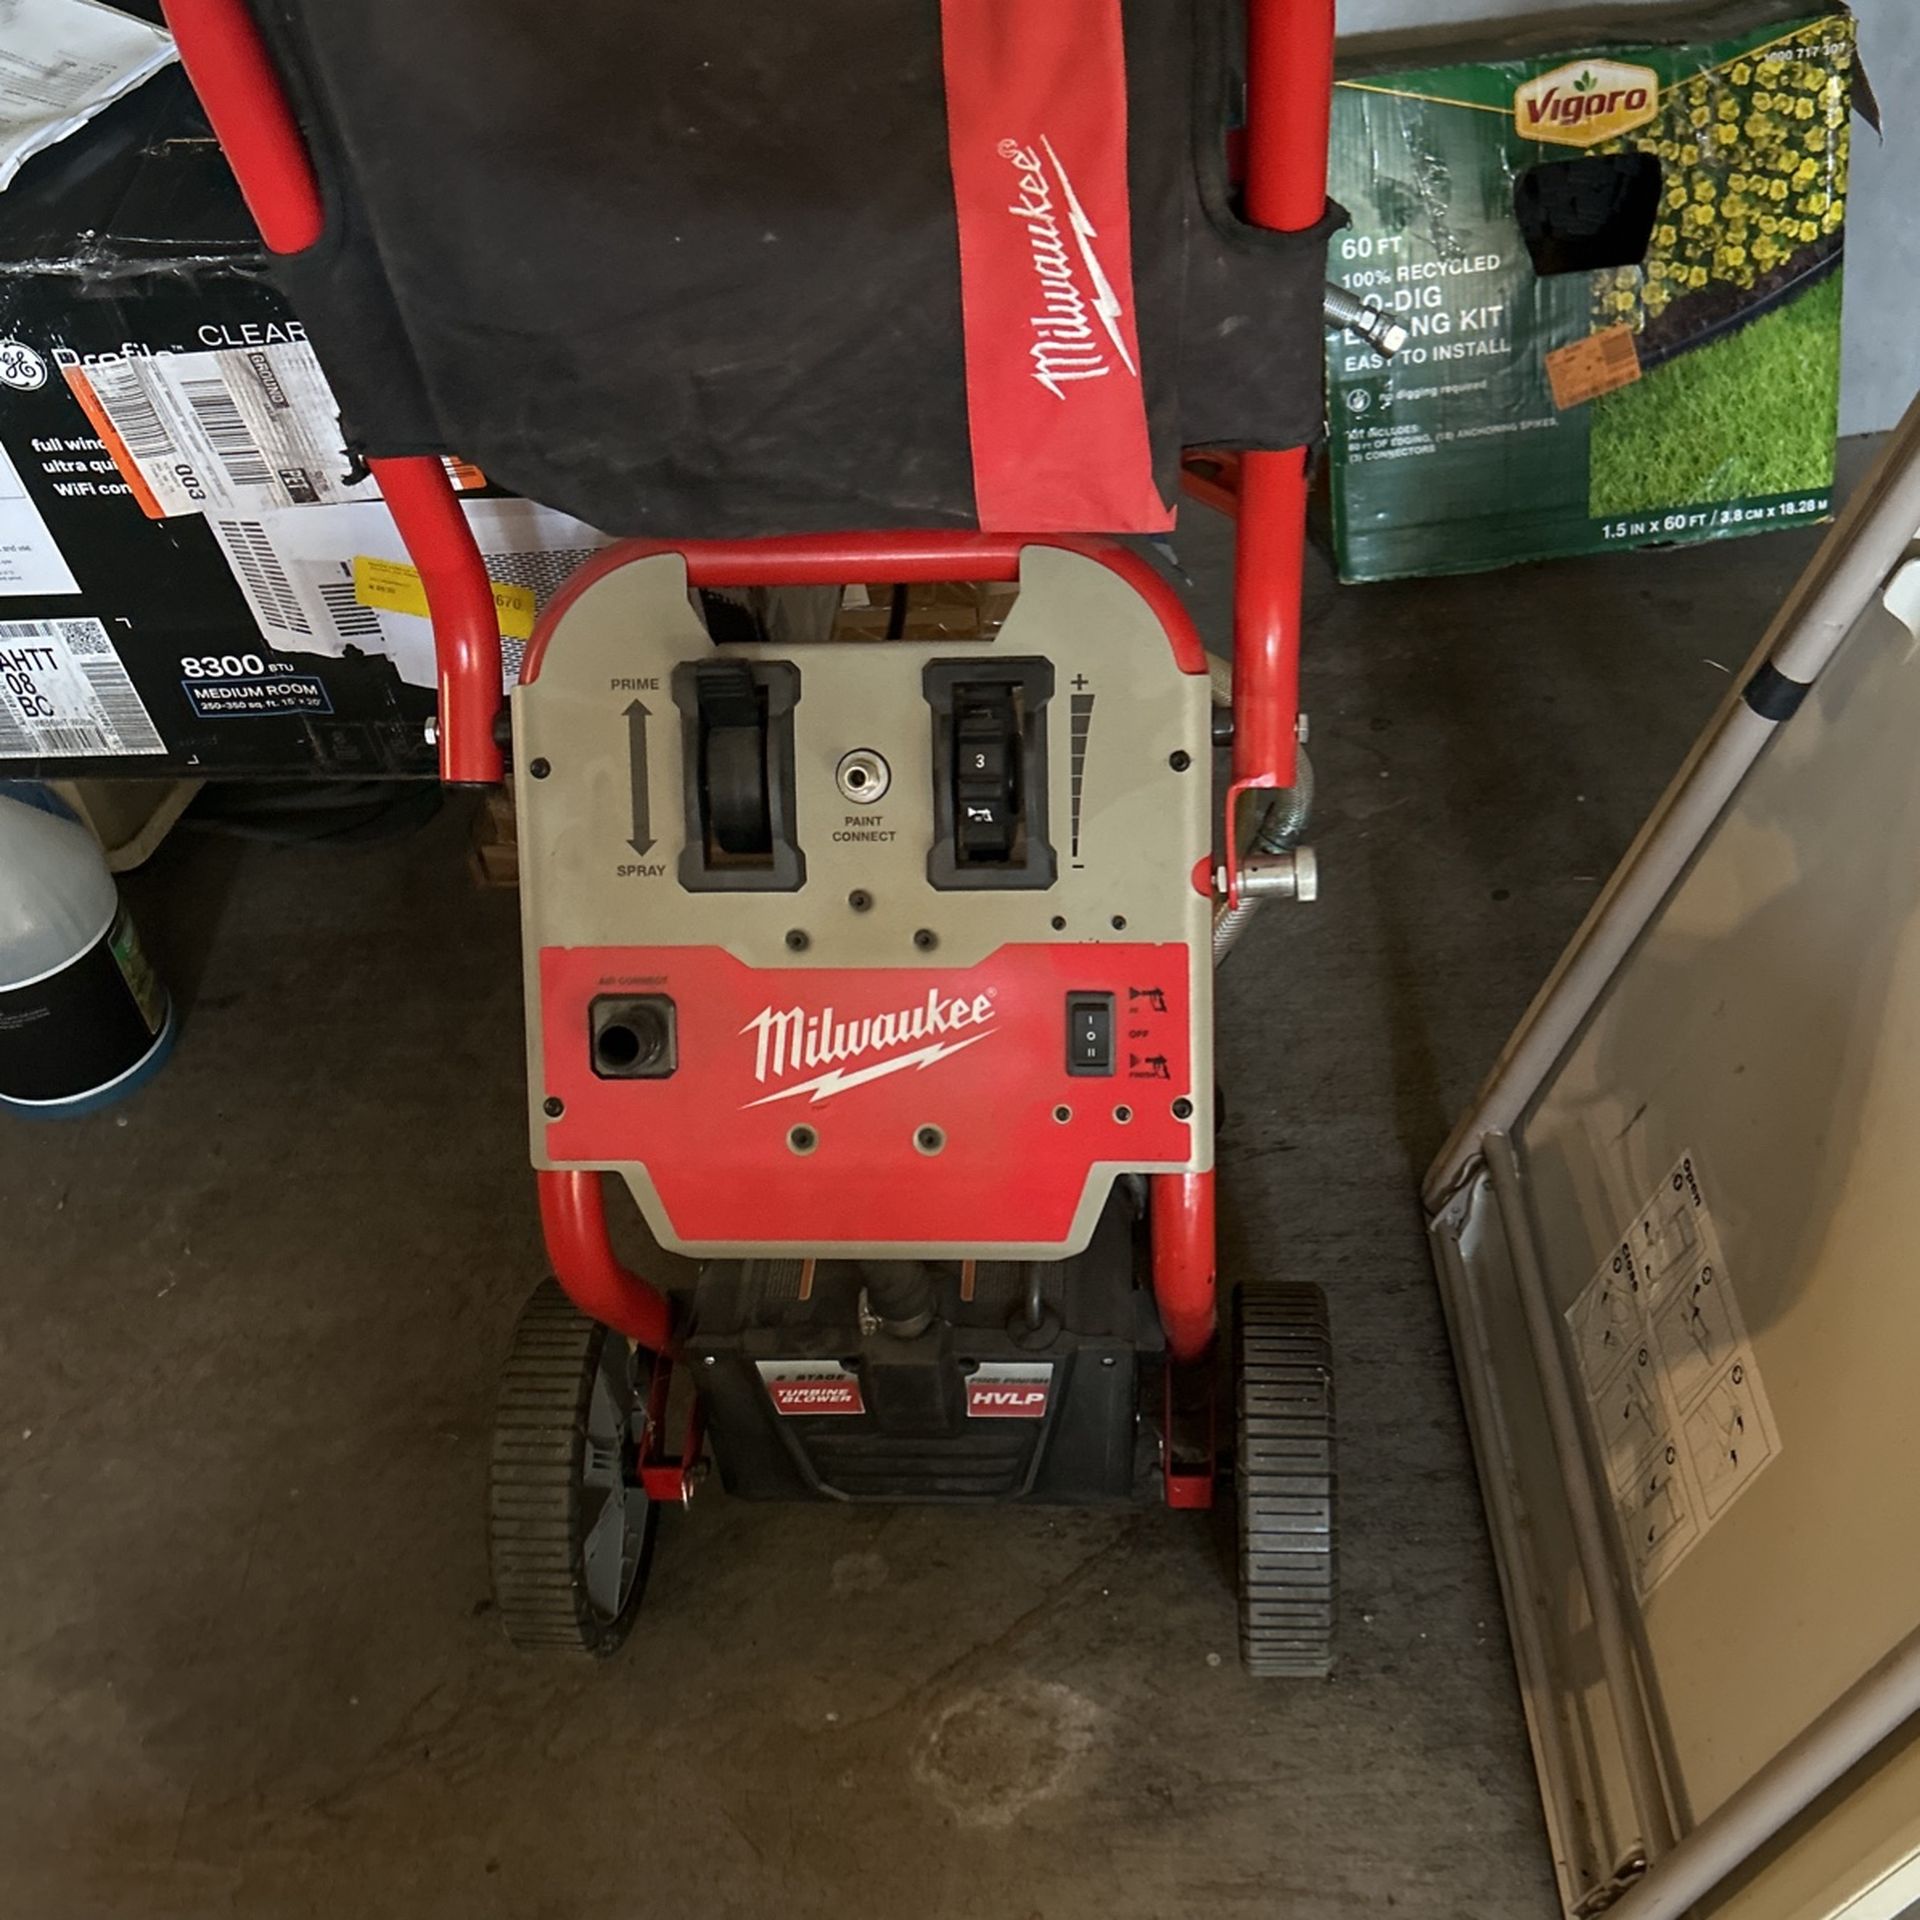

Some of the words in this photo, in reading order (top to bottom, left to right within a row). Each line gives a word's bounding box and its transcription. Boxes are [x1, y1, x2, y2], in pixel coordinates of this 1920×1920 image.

[1796, 46, 1819, 58] 717
[1526, 86, 1648, 126] Vigoro
[1341, 236, 1372, 260] 60
[1377, 236, 1402, 254] FT
[1008, 144, 1110, 400] Milwaukee
[1342, 269, 1392, 288] 100%
[1396, 254, 1501, 282] RECYCLED
[1362, 285, 1443, 313] O-DIG
[1460, 305, 1504, 332] KIT
[198, 321, 309, 347] CLEAR
[1401, 347, 1428, 365] TO
[1433, 338, 1511, 361] INSTALL
[252, 353, 285, 403] GROUND
[31, 438, 63, 453] full
[42, 460, 88, 474] ultra
[53, 483, 96, 497] WiFi
[174, 463, 207, 500] 003
[1602, 523, 1626, 539] 1.5
[1630, 524, 1645, 535] IN
[1664, 515, 1686, 531] 60
[1689, 513, 1706, 527] FT
[1720, 508, 1743, 523] 3.8
[1745, 508, 1764, 520] CM
[1818, 499, 1829, 510] M
[181, 654, 264, 678] 8300
[267, 663, 294, 673] BTU
[6, 672, 36, 695] 08
[194, 686, 264, 700] MEDIUM
[266, 683, 318, 698] ROOM
[611, 678, 660, 691] PRIME
[18, 695, 54, 718] BC
[200, 701, 247, 711] 250-350
[975, 753, 985, 769] 3
[845, 816, 883, 828] PAINT
[832, 831, 896, 843] CONNECT
[617, 864, 666, 877] SPRAY
[738, 988, 996, 1083] Milwaukee
[1129, 1030, 1149, 1039] OFF
[778, 1388, 849, 1397] TURBINE
[781, 1395, 852, 1403] BLOWER
[972, 1391, 1045, 1405] HVLP
